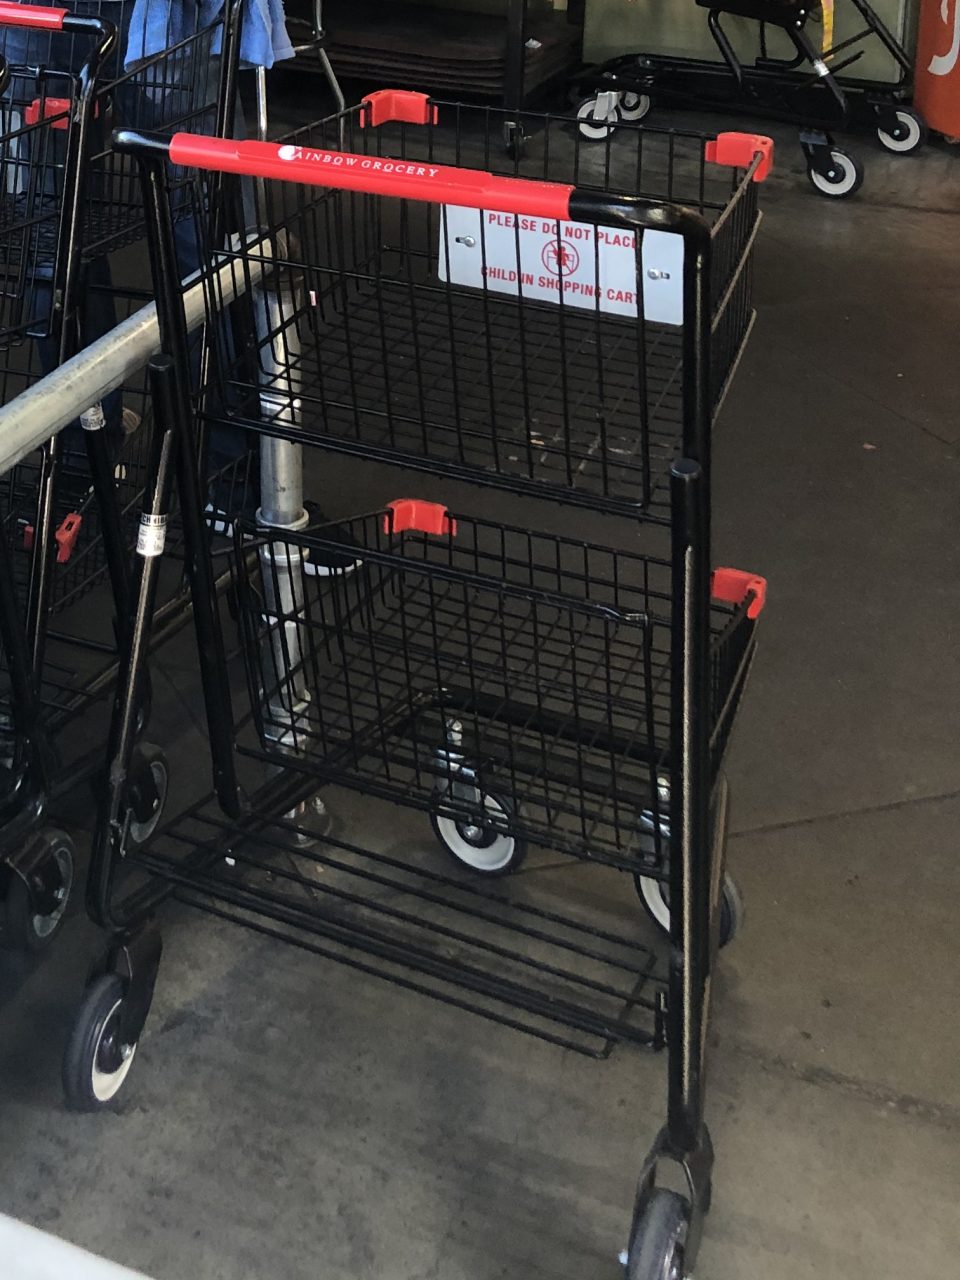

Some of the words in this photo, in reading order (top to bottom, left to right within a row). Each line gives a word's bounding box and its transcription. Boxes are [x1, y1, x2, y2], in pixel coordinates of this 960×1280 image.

[361, 160, 439, 177] GROCERY
[565, 226, 591, 241] NOT
[521, 273, 534, 286] IN
